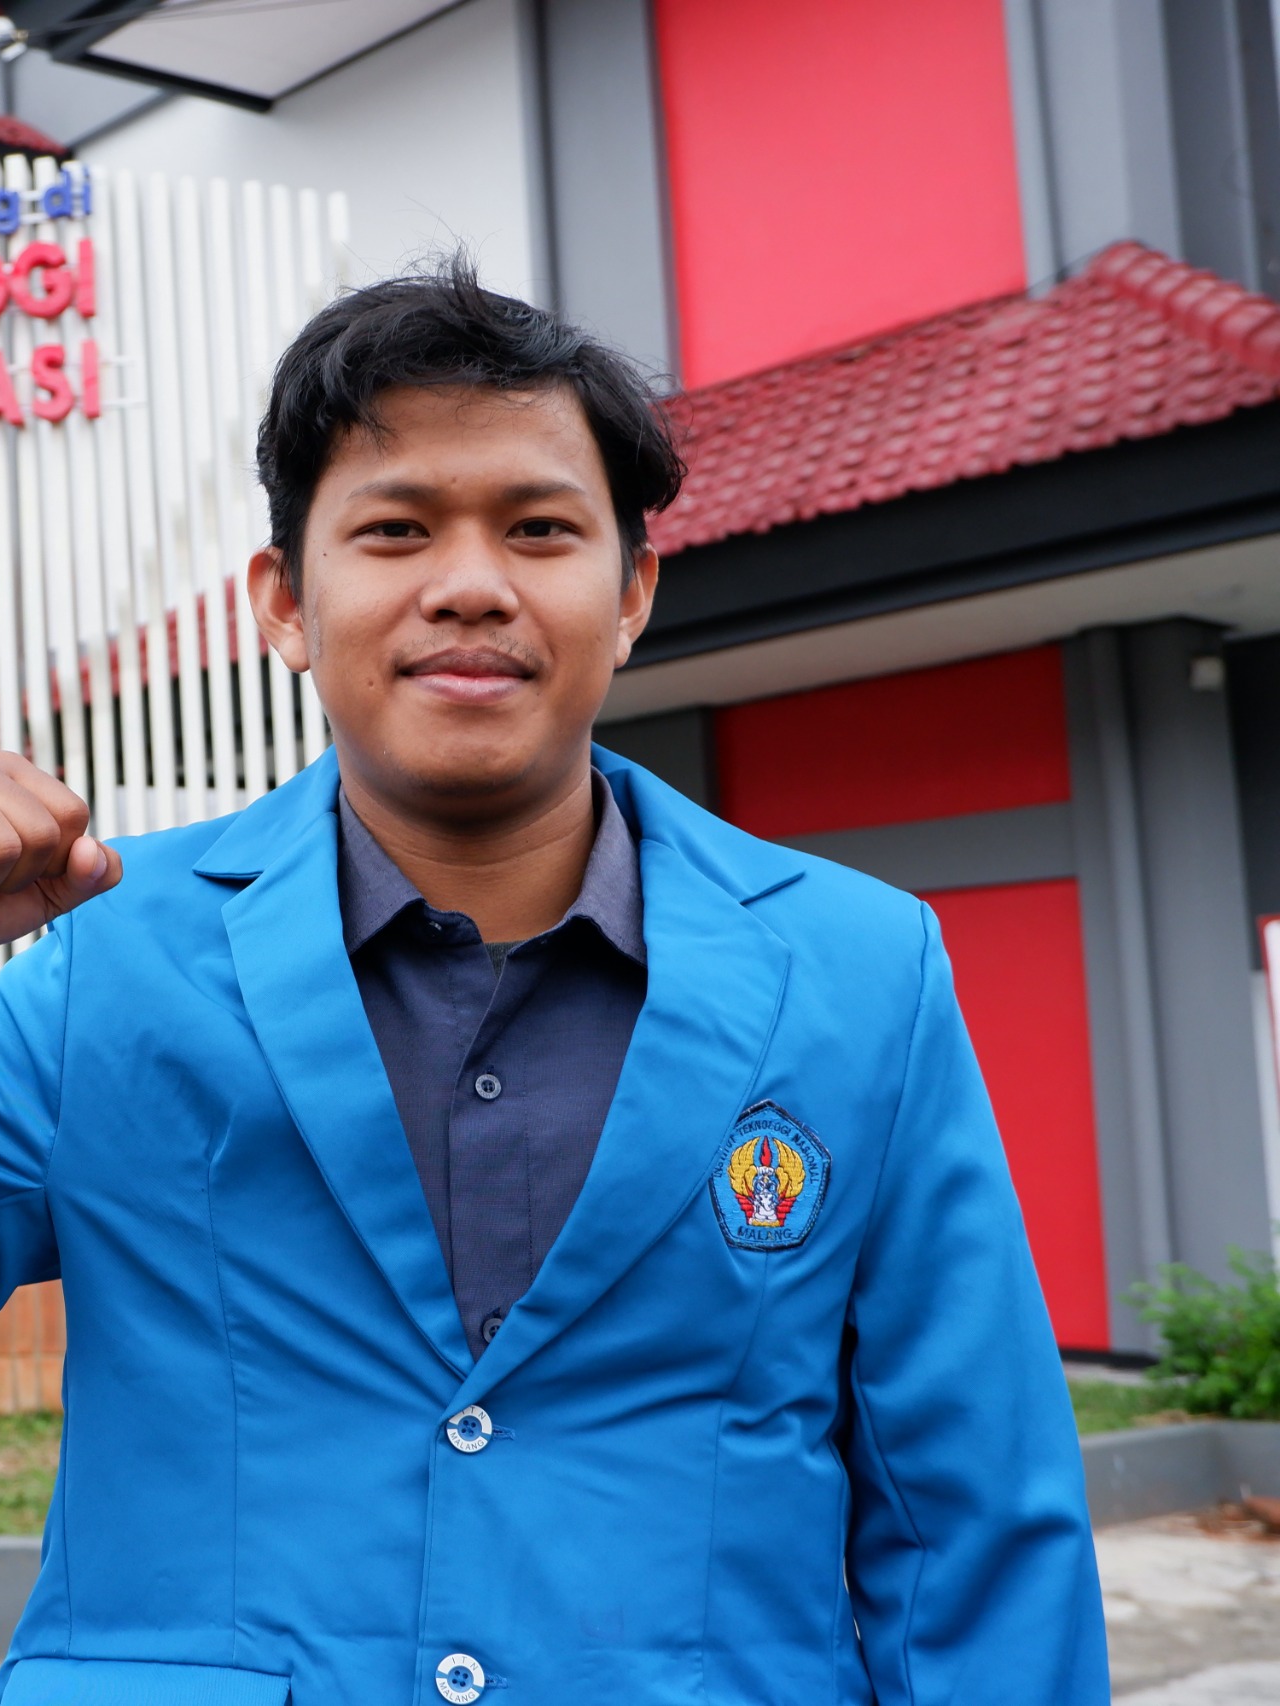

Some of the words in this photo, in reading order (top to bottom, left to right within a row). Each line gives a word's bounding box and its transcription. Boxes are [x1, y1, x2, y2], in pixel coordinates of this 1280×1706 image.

[43, 165, 91, 219] di
[736, 1119, 792, 1137] TEKNOLOGI
[791, 1133, 820, 1184] NASIONAL
[737, 1225, 793, 1241] MALANG
[450, 1431, 485, 1451] MALANG
[451, 1655, 479, 1671] ITN
[439, 1681, 476, 1702] MALANG
